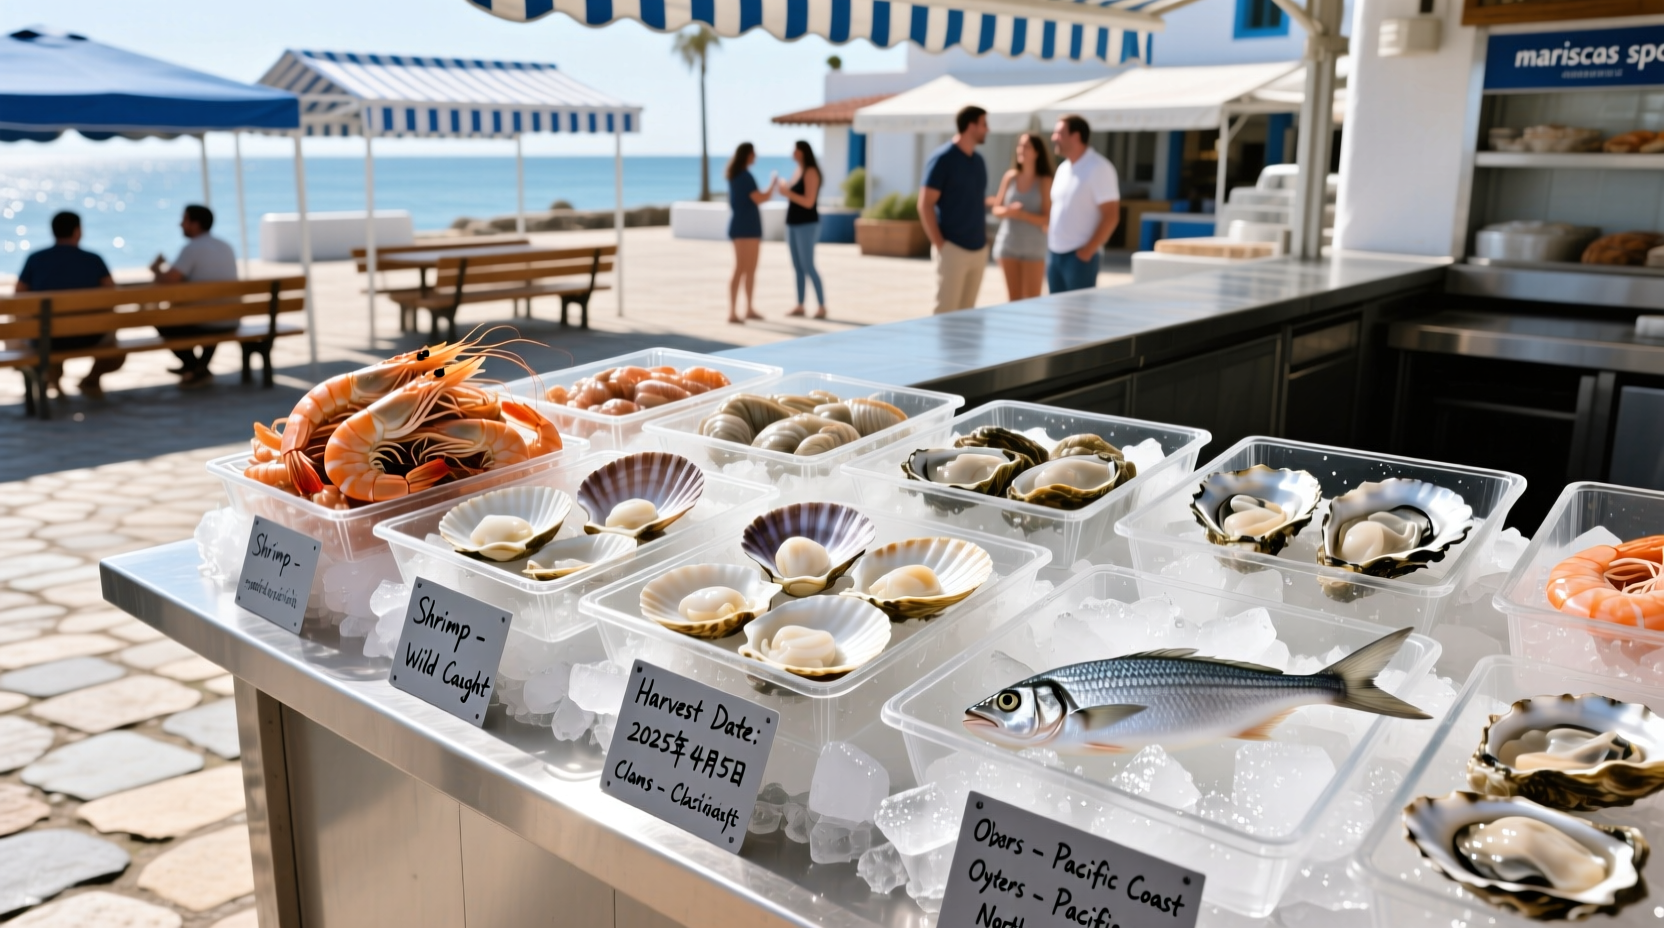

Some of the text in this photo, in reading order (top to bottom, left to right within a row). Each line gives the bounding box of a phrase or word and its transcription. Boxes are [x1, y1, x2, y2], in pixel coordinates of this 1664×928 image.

[251, 532, 291, 577] Shrimp
[412, 595, 471, 653] Shrimp
[405, 641, 491, 704] Wild Caught
[634, 676, 761, 745] Harvest Date:
[968, 858, 1026, 899] Oyters
[973, 817, 1025, 855] Obars
[1052, 841, 1119, 890] Pacific
[1126, 874, 1186, 918] Coast
